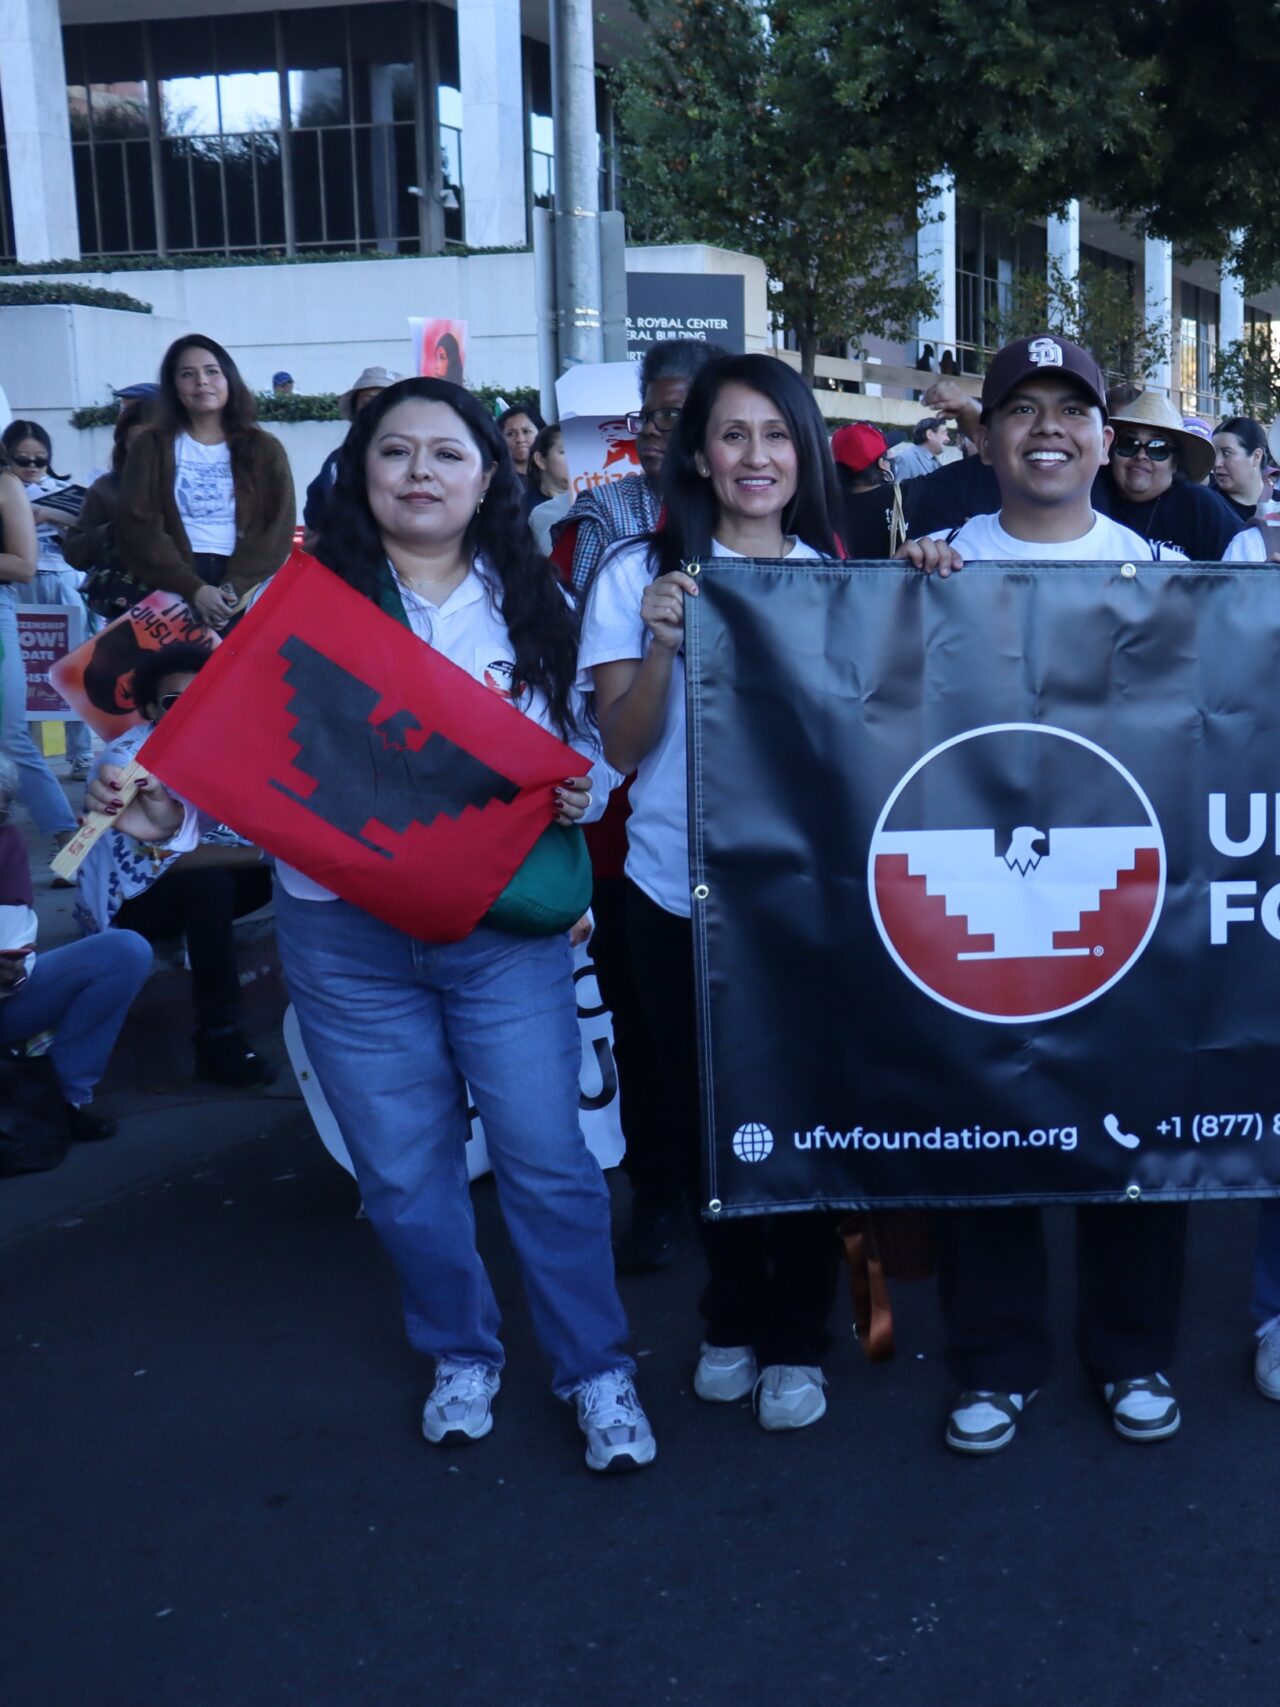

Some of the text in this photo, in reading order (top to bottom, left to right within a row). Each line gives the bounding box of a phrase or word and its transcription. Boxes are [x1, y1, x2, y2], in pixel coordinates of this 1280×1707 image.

[637, 317, 684, 329] ROYBAL
[686, 318, 728, 329] CENTER
[626, 330, 706, 341] ERAL BUILDING
[1028, 337, 1063, 367] SD
[18, 621, 65, 629] ZENSHIP
[20, 631, 65, 648] OW!
[22, 650, 55, 661] DATE
[1156, 1116, 1181, 1138] +1
[1192, 1113, 1263, 1142] (877)
[793, 1125, 1079, 1151] ufwfoundation.org
